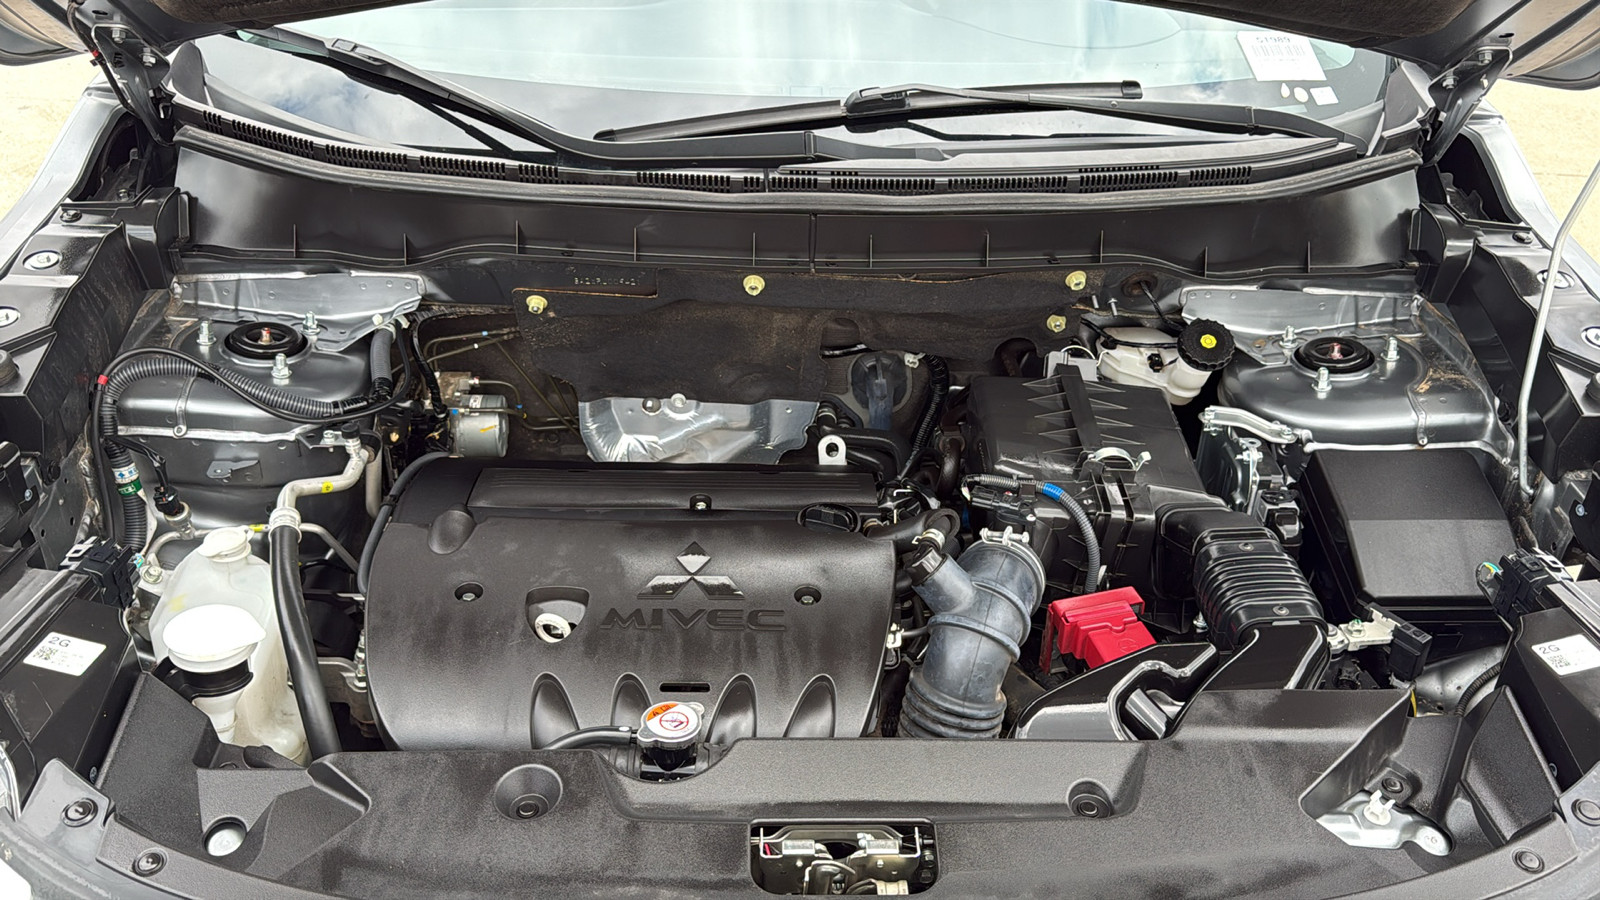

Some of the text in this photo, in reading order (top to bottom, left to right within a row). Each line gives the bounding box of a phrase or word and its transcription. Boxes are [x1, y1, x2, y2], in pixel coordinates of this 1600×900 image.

[600, 607, 786, 631] MIVEC
[48, 636, 71, 647] 2G
[1539, 644, 1561, 654] 2G
